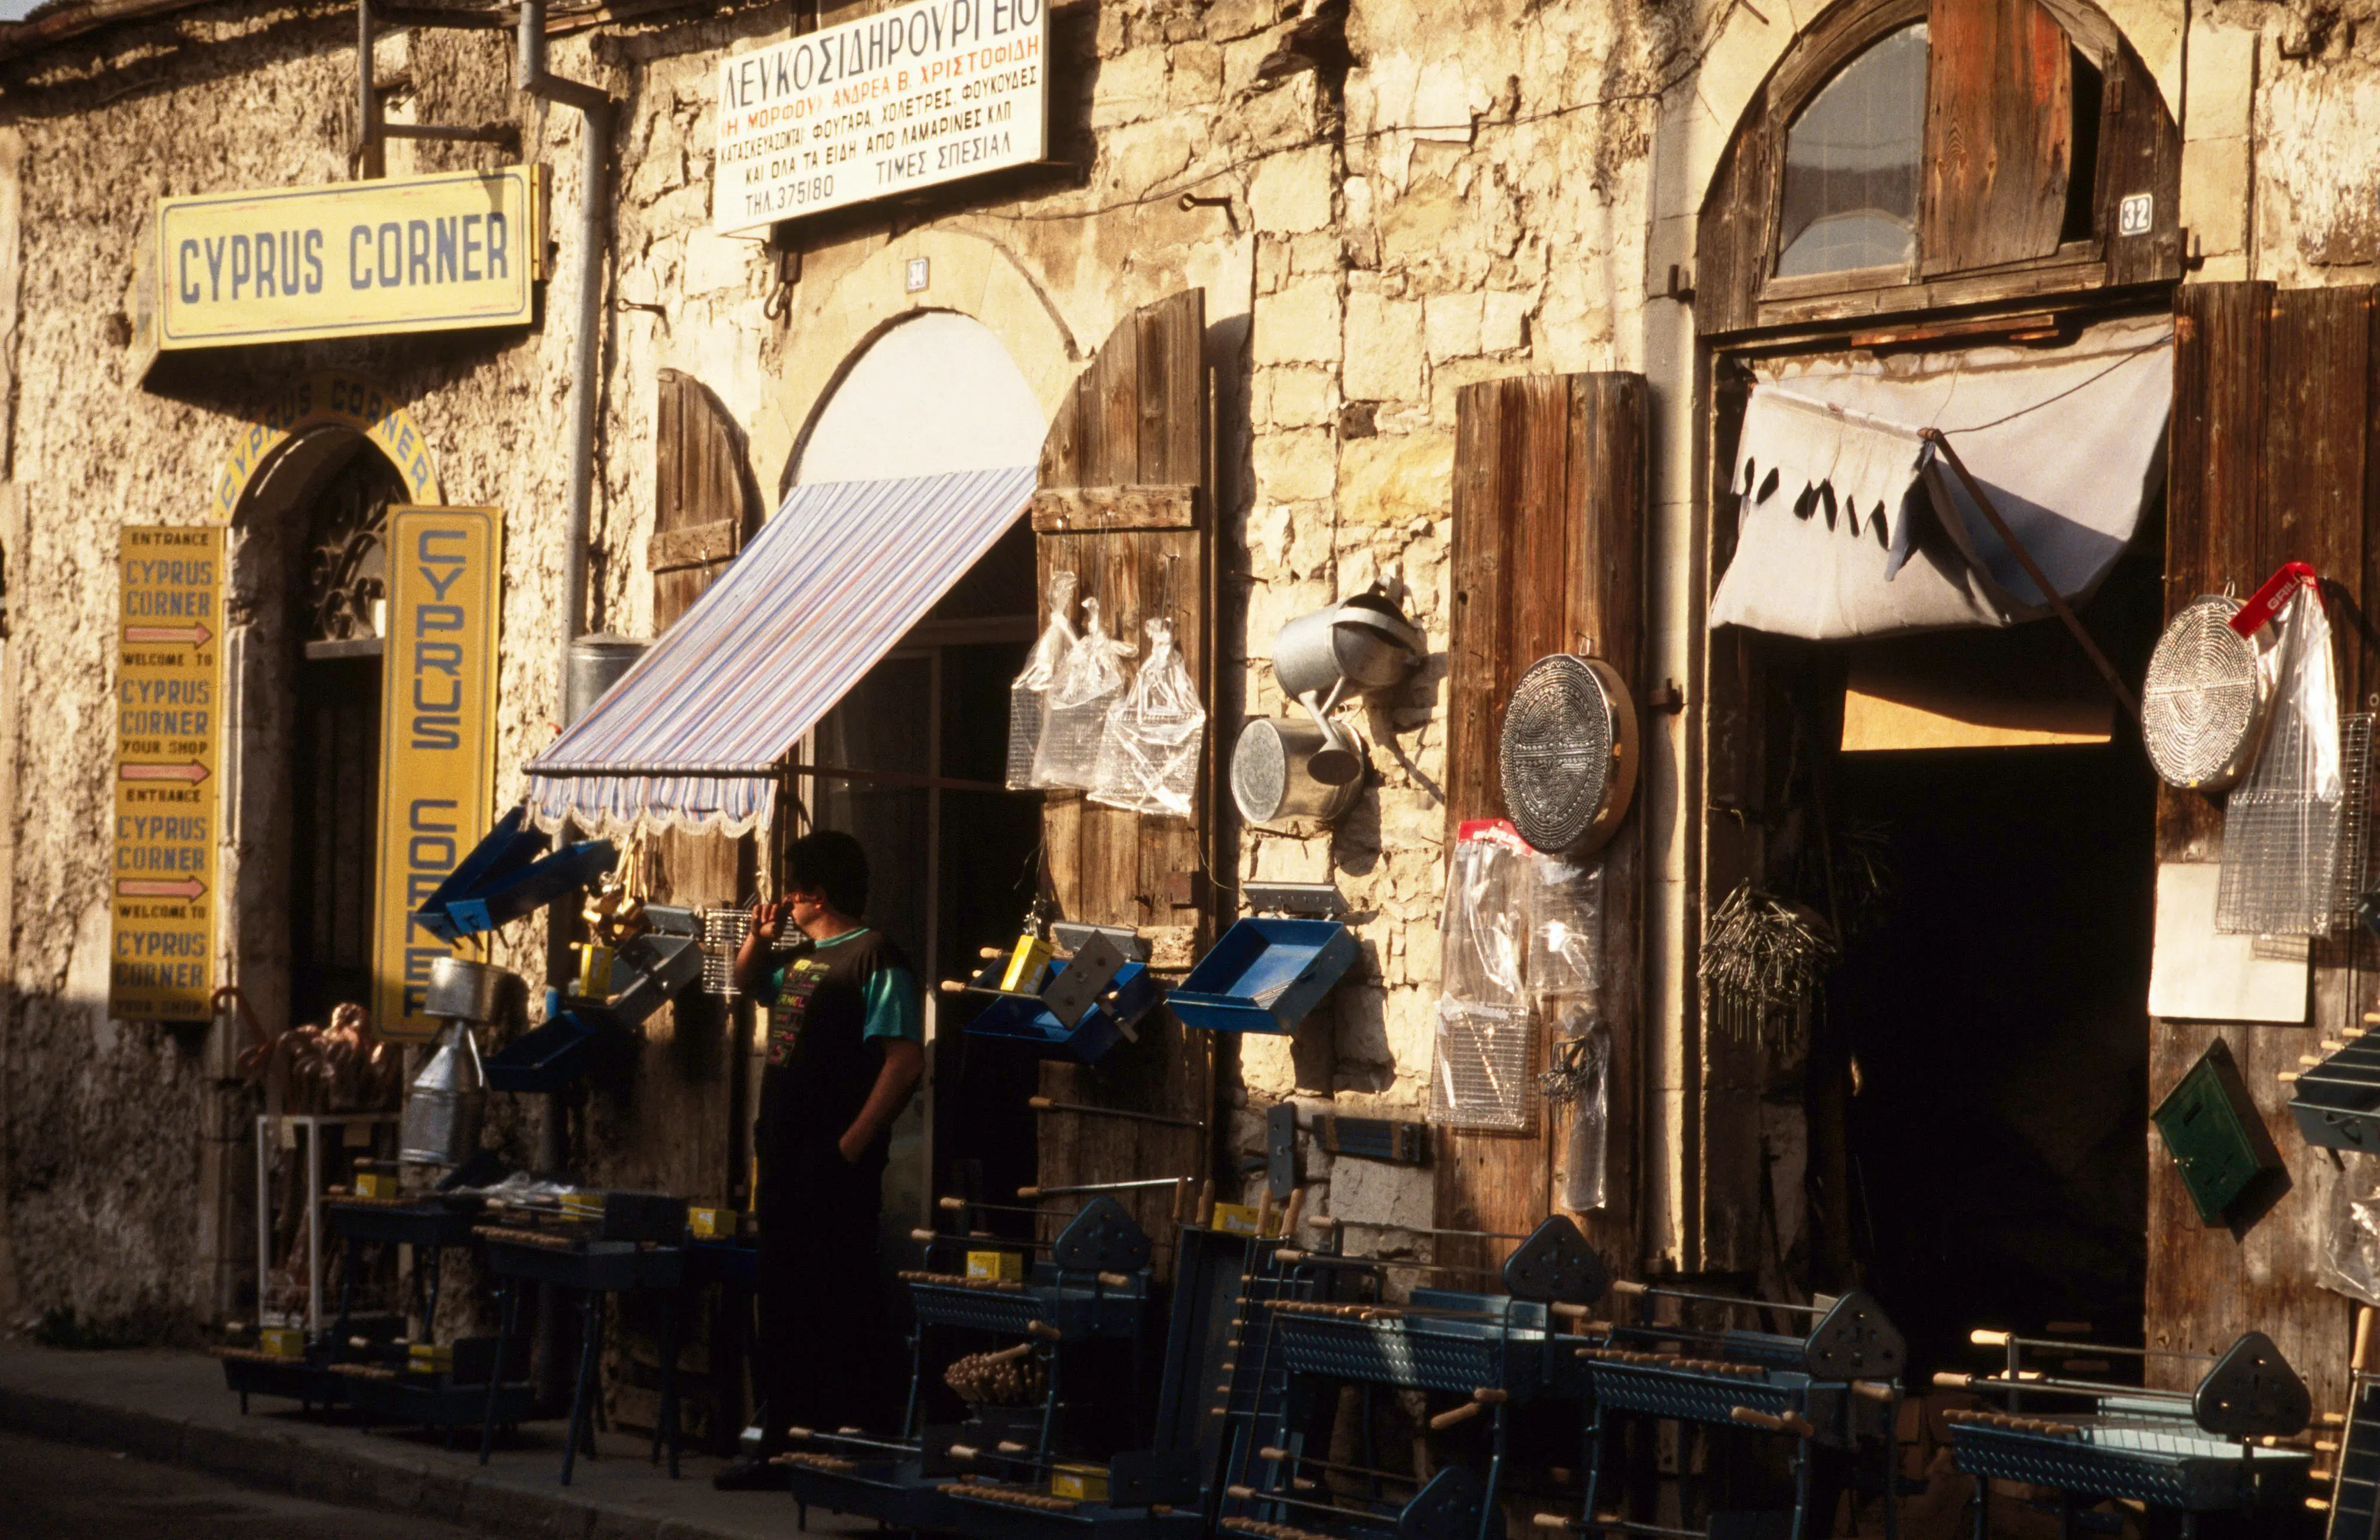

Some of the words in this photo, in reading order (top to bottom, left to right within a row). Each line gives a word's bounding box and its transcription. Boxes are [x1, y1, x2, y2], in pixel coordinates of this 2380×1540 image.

[832, 76, 890, 109] ΑΝΔΡΕΑ
[920, 35, 1039, 85] ΧΡΙΣΤΟΦΙΔΗ
[962, 66, 1036, 101] ΦΟΥΚΟΥΔΕΣ
[745, 164, 764, 186] ΚΑΙ
[771, 156, 795, 179] ΟΛΑ
[803, 151, 818, 171] ΤΑ
[826, 140, 857, 166] ΕΙΔΗ
[865, 131, 894, 156] ΑΠΟ
[901, 108, 982, 147] ΛΑΜΑΡΙΝΕΣ
[988, 100, 1011, 124] ΚΛΠ
[876, 150, 927, 185] ΤΙΜΕΣ
[938, 131, 1011, 171] ΣΠΕΣΙΑΛ
[2124, 199, 2148, 230] 32
[180, 228, 323, 304] CYPRUS
[349, 211, 508, 290] CORNER
[221, 383, 312, 511] CYPRUS
[331, 378, 428, 495] CORNER
[131, 533, 209, 547] ENTRANCE
[125, 559, 213, 586] CYPRUS
[125, 590, 211, 617] CORNER
[412, 530, 466, 750] CYPRUS
[122, 653, 184, 667] WELCOME
[196, 653, 213, 667] TO
[121, 679, 211, 706] CYPRUS
[120, 710, 209, 736] CORNER
[121, 740, 161, 755] YOUR
[168, 740, 208, 755] SHOP
[126, 789, 202, 803] ENTRANCE
[118, 815, 207, 842] CYPRUS
[117, 846, 205, 872] CORNER
[119, 904, 187, 919] WELCOME
[191, 905, 206, 919] TO
[116, 931, 206, 958] CYPRUS
[114, 962, 203, 989] CORNER
